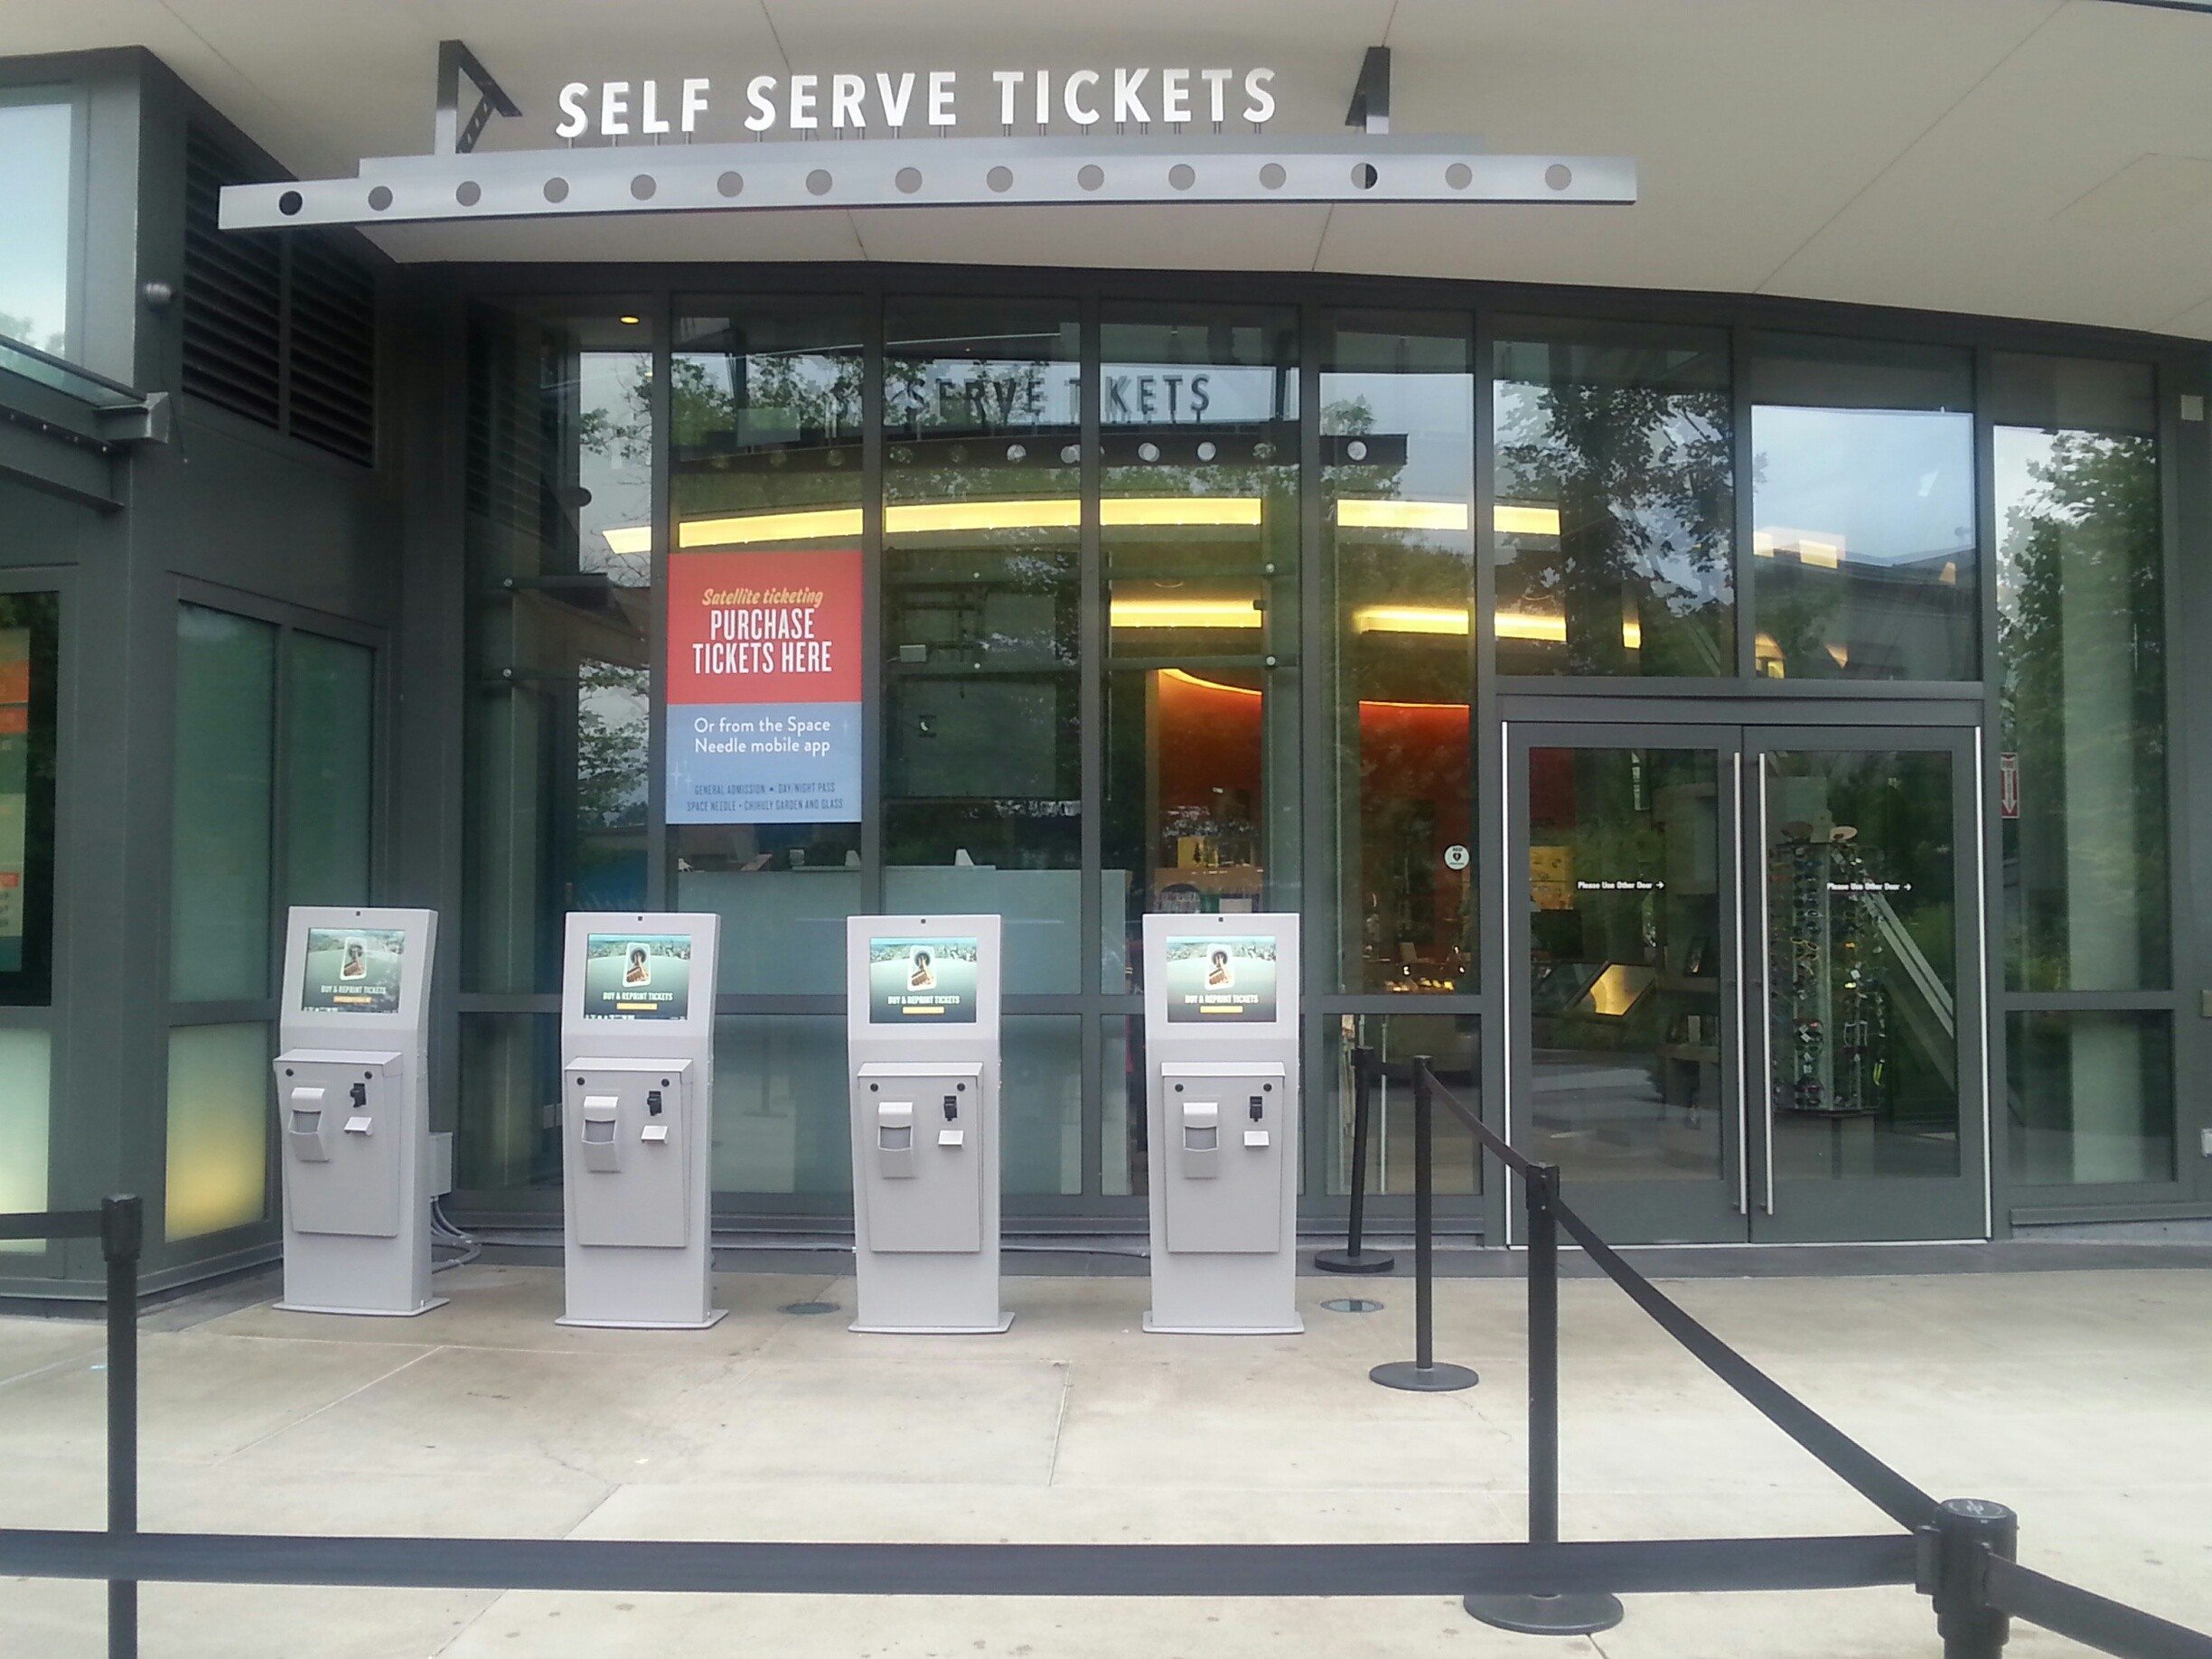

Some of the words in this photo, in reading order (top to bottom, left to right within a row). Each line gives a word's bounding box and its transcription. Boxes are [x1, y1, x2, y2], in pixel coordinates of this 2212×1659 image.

[556, 79, 710, 138] SELF
[744, 71, 958, 133] SERVE
[992, 68, 1277, 125] TICKETS
[702, 588, 760, 606] Satellite
[763, 587, 824, 608] ticketing
[710, 608, 815, 640] PURCHASE
[692, 642, 774, 674] TICKETS
[782, 641, 832, 673] HERE
[694, 717, 715, 733] Or
[719, 717, 754, 733] from
[759, 717, 783, 732] the
[787, 716, 831, 737] Space
[695, 737, 746, 754] Needle
[751, 736, 800, 753] mobile
[804, 740, 830, 756] app
[695, 784, 724, 795] GENERAL
[727, 784, 765, 794] ADMISSION
[687, 801, 708, 811] SPACE
[1578, 881, 1600, 889] Please
[1601, 881, 1615, 889] Use
[1617, 881, 1636, 889] Other
[1636, 881, 1653, 889] Door
